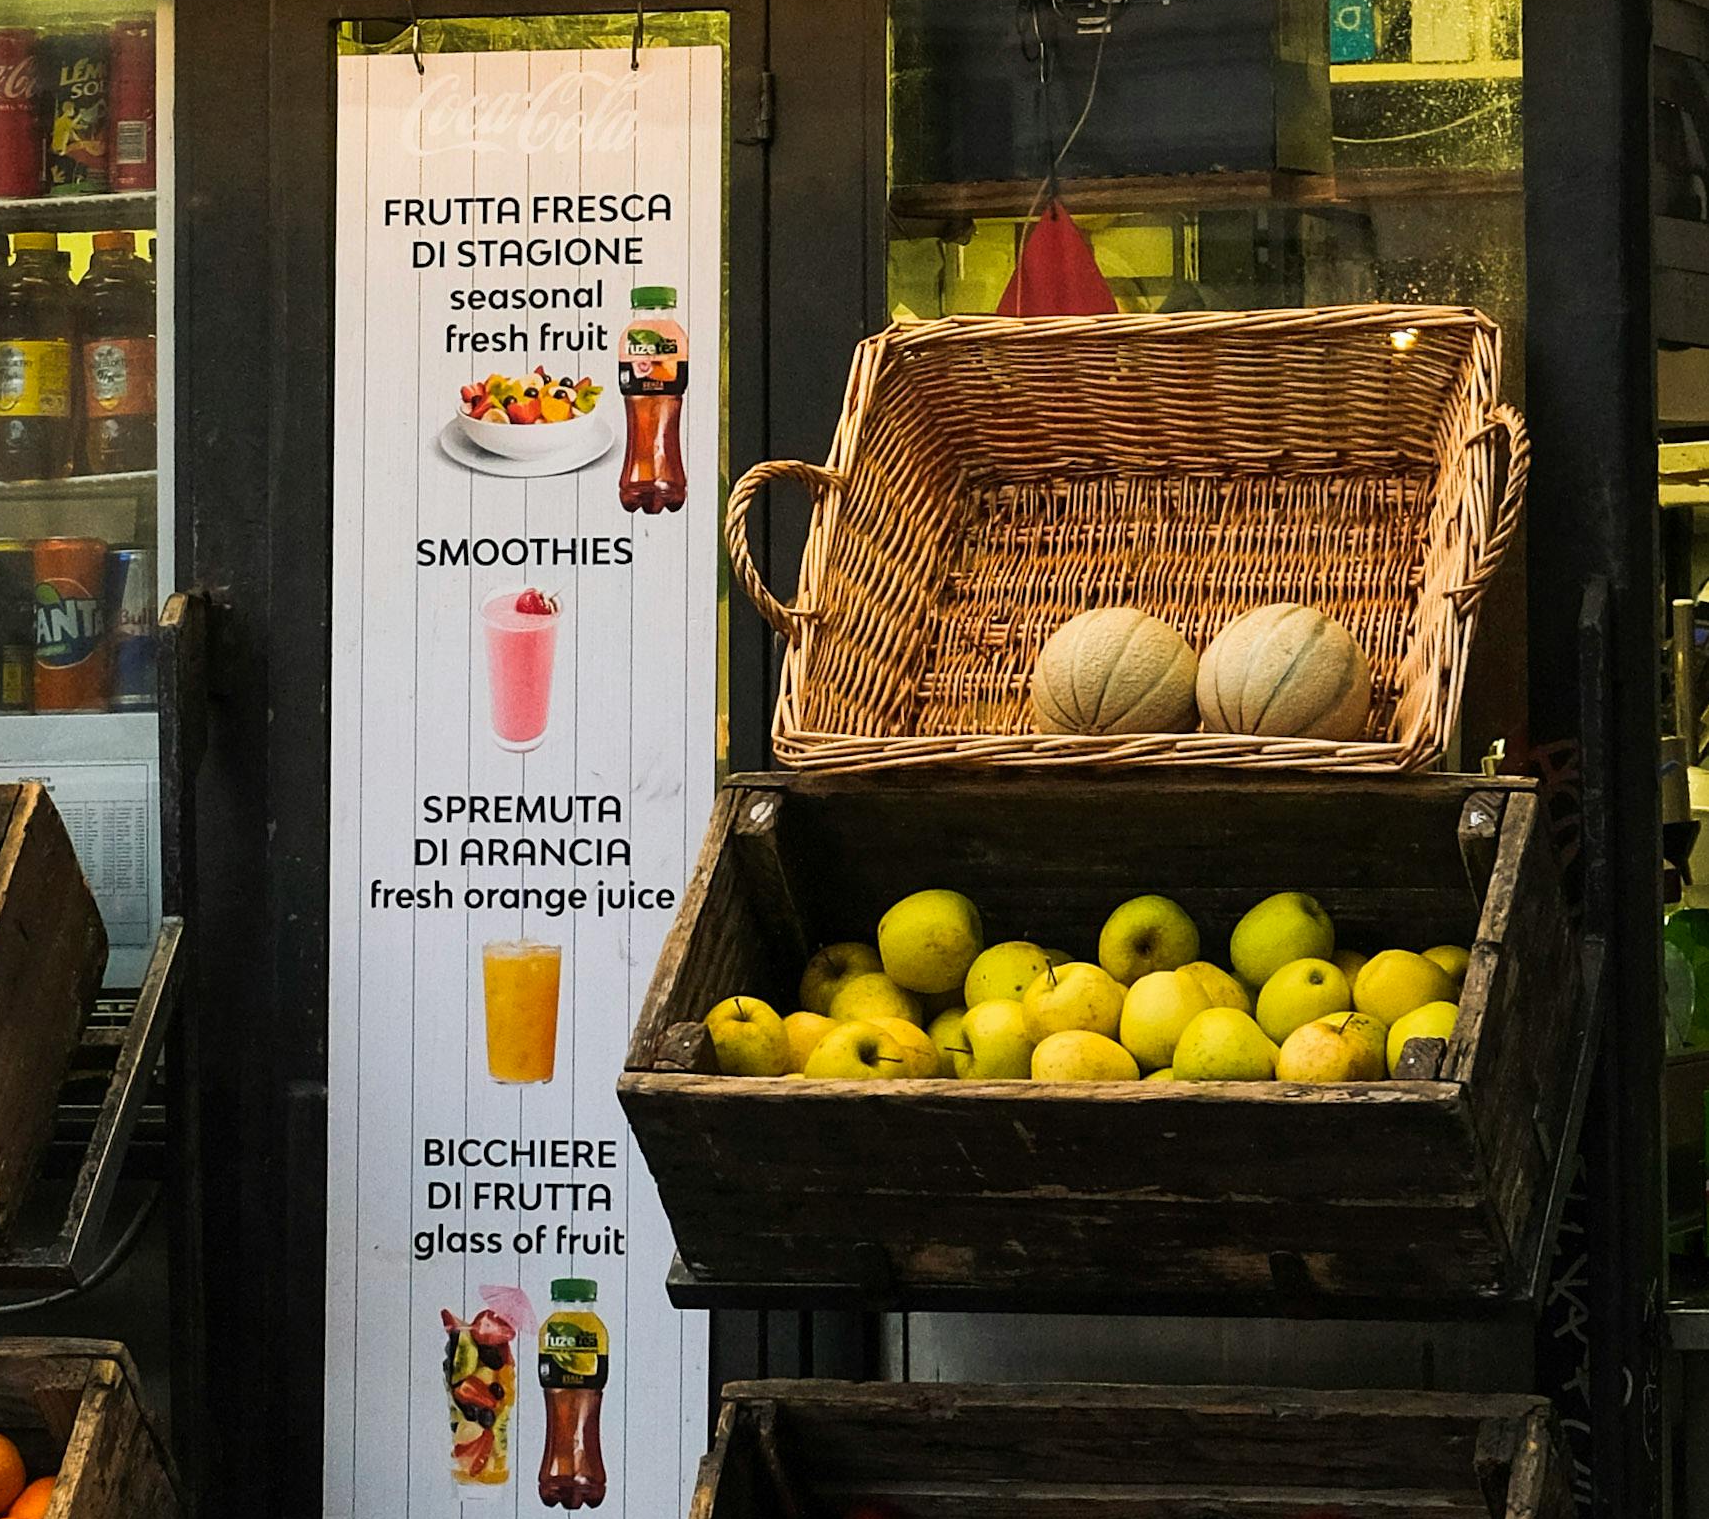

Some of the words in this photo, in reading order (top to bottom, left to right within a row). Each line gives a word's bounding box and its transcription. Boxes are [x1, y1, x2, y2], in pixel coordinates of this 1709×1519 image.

[384, 197, 520, 226] FRUTTA
[533, 194, 672, 223] FRESCA
[412, 240, 445, 268] DI
[458, 237, 643, 267] STAGIONE
[450, 281, 603, 311] seasonal
[445, 323, 528, 353] fresh
[539, 322, 608, 352] fruit
[416, 537, 633, 566] SMOOTHIES
[423, 795, 622, 824] SPREMUTA
[414, 838, 447, 866] DI
[461, 837, 631, 866] ARANCIA
[370, 879, 453, 909] fresh
[463, 884, 588, 916] orange
[597, 880, 675, 917] juice
[423, 1138, 617, 1168] BICCHIERE
[428, 1182, 462, 1210] DI
[473, 1182, 612, 1212] FRUTTA
[414, 1223, 502, 1261] glass
[512, 1225, 547, 1254] of
[555, 1225, 625, 1256] fruit
